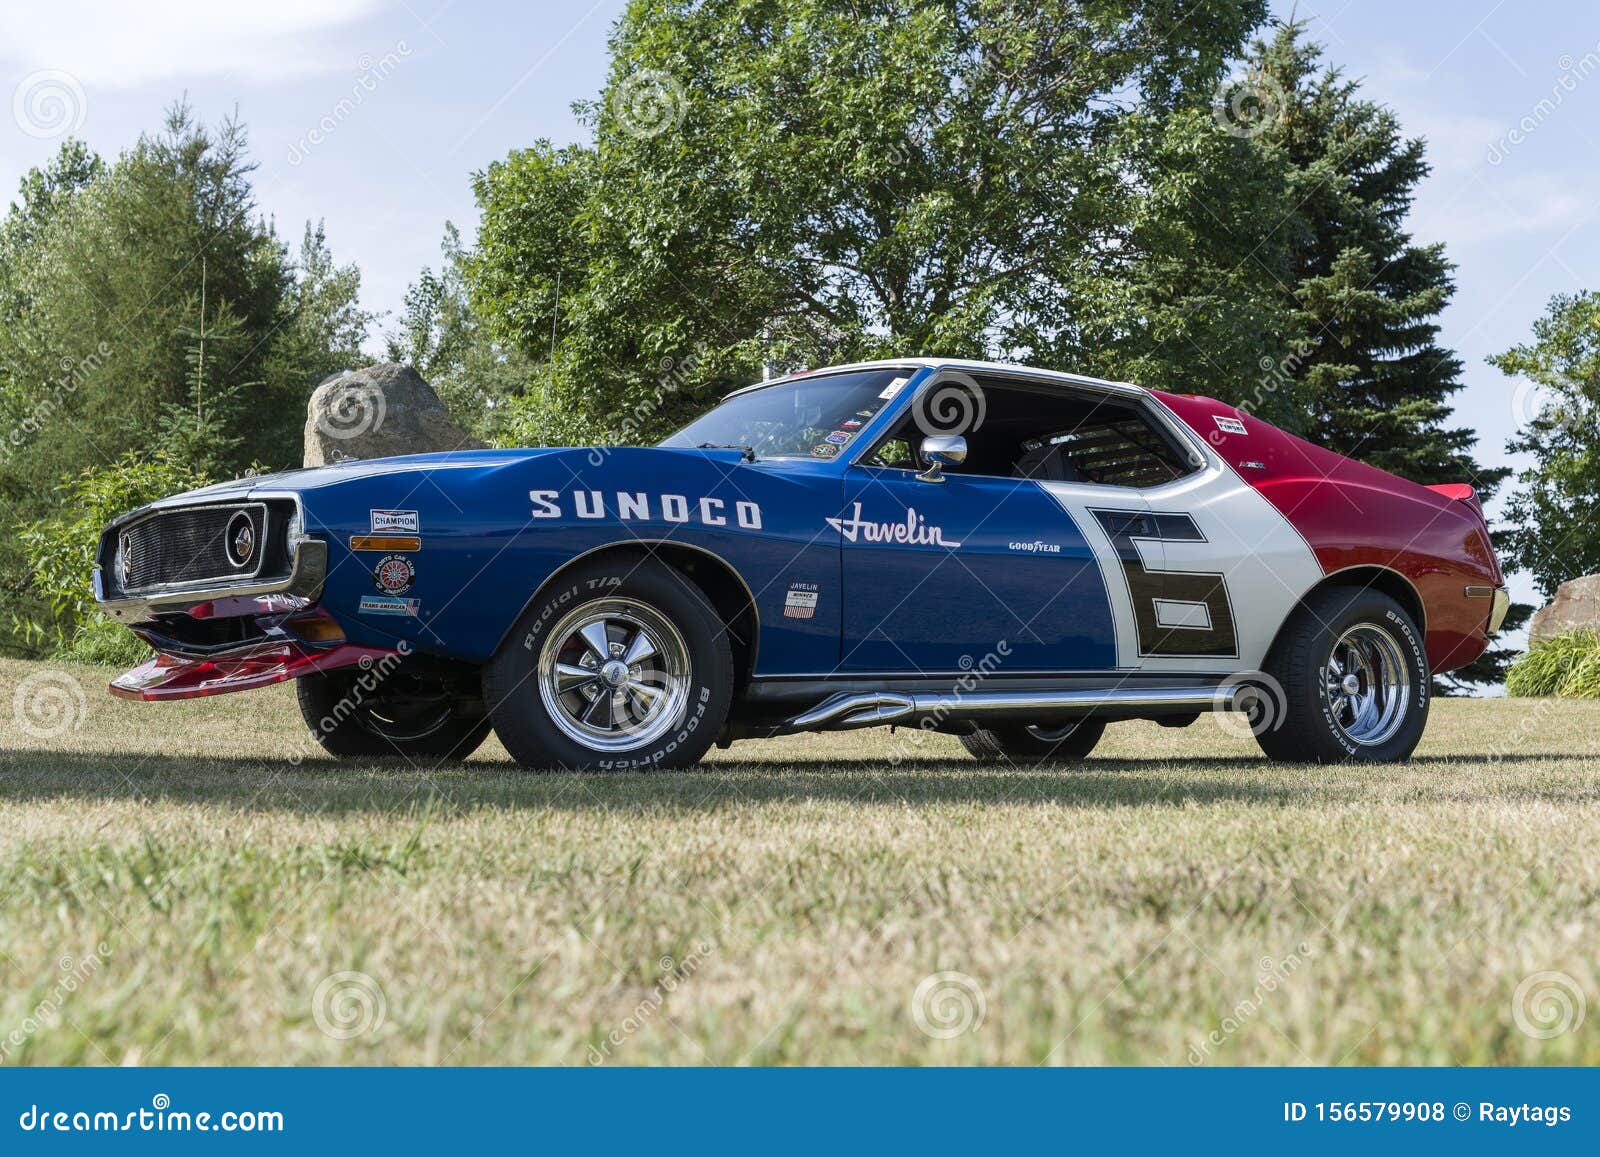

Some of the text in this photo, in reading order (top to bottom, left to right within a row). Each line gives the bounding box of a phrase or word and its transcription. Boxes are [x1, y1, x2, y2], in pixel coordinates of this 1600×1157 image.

[375, 517, 415, 525] CHAMPION
[529, 490, 762, 530] SUNOCO
[825, 502, 961, 548] Javelin
[1009, 541, 1060, 552] GOODYEAR
[1084, 506, 1241, 660] 6
[524, 576, 622, 650] Radial T/A
[1385, 610, 1426, 709] BFGoodrich
[599, 686, 710, 769] BFGoodrich
[1322, 707, 1357, 755] Radial
